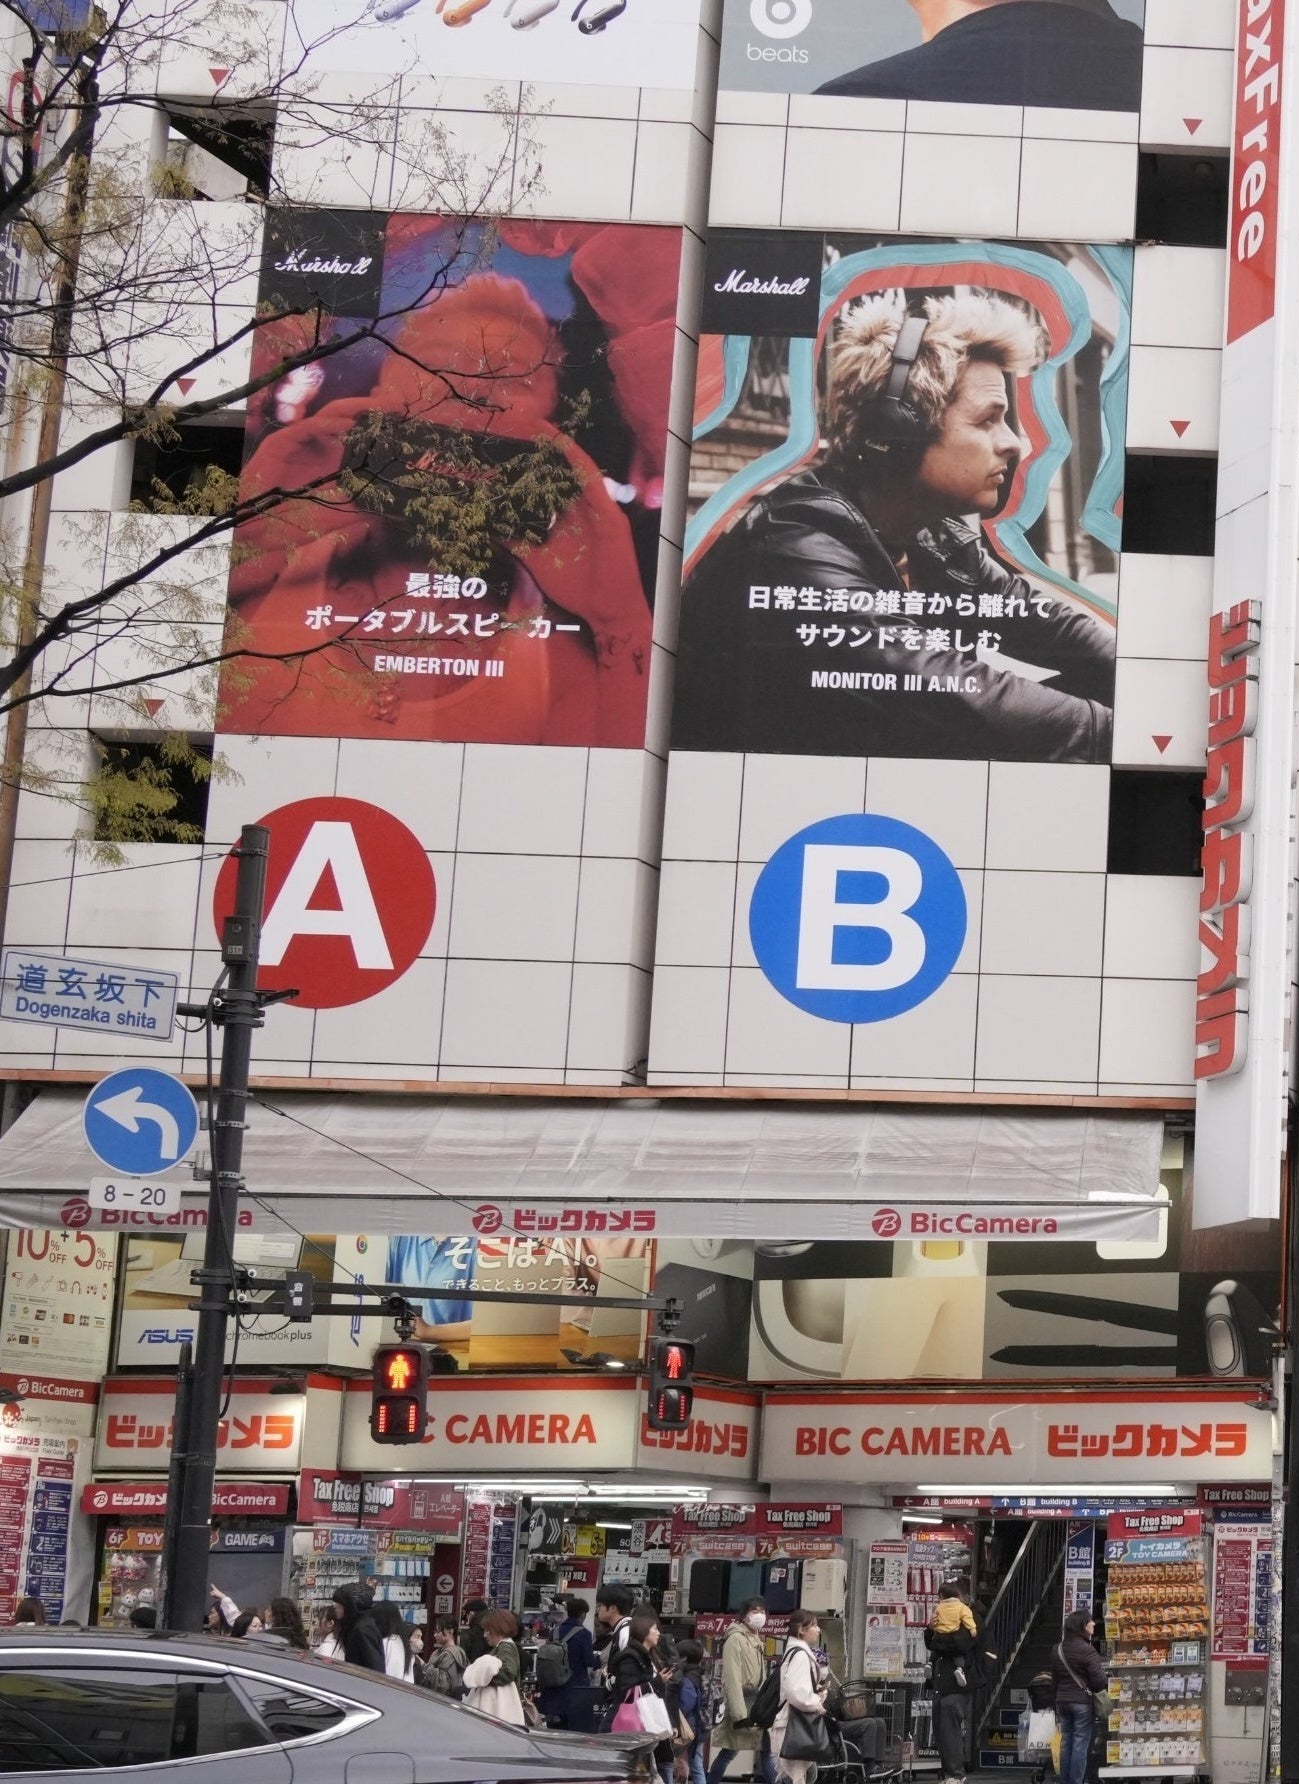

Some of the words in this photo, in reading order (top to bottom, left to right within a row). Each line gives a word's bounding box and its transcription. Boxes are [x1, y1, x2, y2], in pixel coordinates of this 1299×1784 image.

[747, 43, 809, 64] beats
[274, 248, 372, 275] Marshall
[714, 269, 810, 296] Marshall
[405, 572, 487, 600] 最強の
[747, 585, 1053, 621] 日常生活の雑音から離れて
[795, 623, 1002, 655] サウンドを楽しむ
[374, 655, 479, 676] EMBERTON
[485, 660, 505, 677] III
[811, 671, 897, 692] MONITOR
[904, 673, 922, 692] III
[927, 674, 982, 694] A.N.C.
[258, 820, 395, 971] A
[796, 844, 926, 992] B
[15, 963, 165, 1008] 道玄坂下
[15, 996, 111, 1026] Dogenzaka
[116, 1010, 157, 1029] shita
[101, 1203, 253, 1227] BicCama
[513, 1209, 656, 1232] ビックカメラ
[910, 1211, 1058, 1235] BicCamera
[48, 1252, 67, 1264] OFF
[95, 1259, 113, 1270] OFF
[138, 1329, 194, 1344] ASUS
[31, 1381, 84, 1398] BicCamera
[106, 1415, 295, 1449] ビッメラ
[445, 1414, 597, 1444] CAMERA
[1047, 1423, 1247, 1457] ビックカメラ
[796, 1426, 851, 1456] BIC
[861, 1426, 1012, 1456] CAMERA
[313, 1478, 332, 1500] Tax
[333, 1479, 361, 1501] Free
[364, 1481, 394, 1507] Shop
[943, 1497, 973, 1508] building
[973, 1497, 981, 1506] A
[1040, 1496, 1069, 1509] building
[1071, 1497, 1078, 1506] B
[1204, 1488, 1220, 1501] Tax
[1222, 1488, 1243, 1501] Free
[1244, 1488, 1270, 1503] Shop
[767, 1510, 784, 1522] Tax
[786, 1509, 808, 1522] Free
[809, 1509, 831, 1523] Shop
[1125, 1516, 1140, 1528] Tax
[1141, 1515, 1160, 1527] Free
[1160, 1514, 1184, 1527] Shop
[109, 1531, 124, 1545] 6F
[137, 1532, 165, 1545] TOY
[225, 1533, 258, 1546] GAME
[697, 1541, 745, 1551] suitcase
[760, 1541, 773, 1554] 7F
[785, 1540, 833, 1551] suitcase
[1068, 1546, 1091, 1560] B館
[1108, 1547, 1125, 1559] 2F
[1131, 1551, 1150, 1559] TOY
[1151, 1550, 1188, 1558] CAMERA
